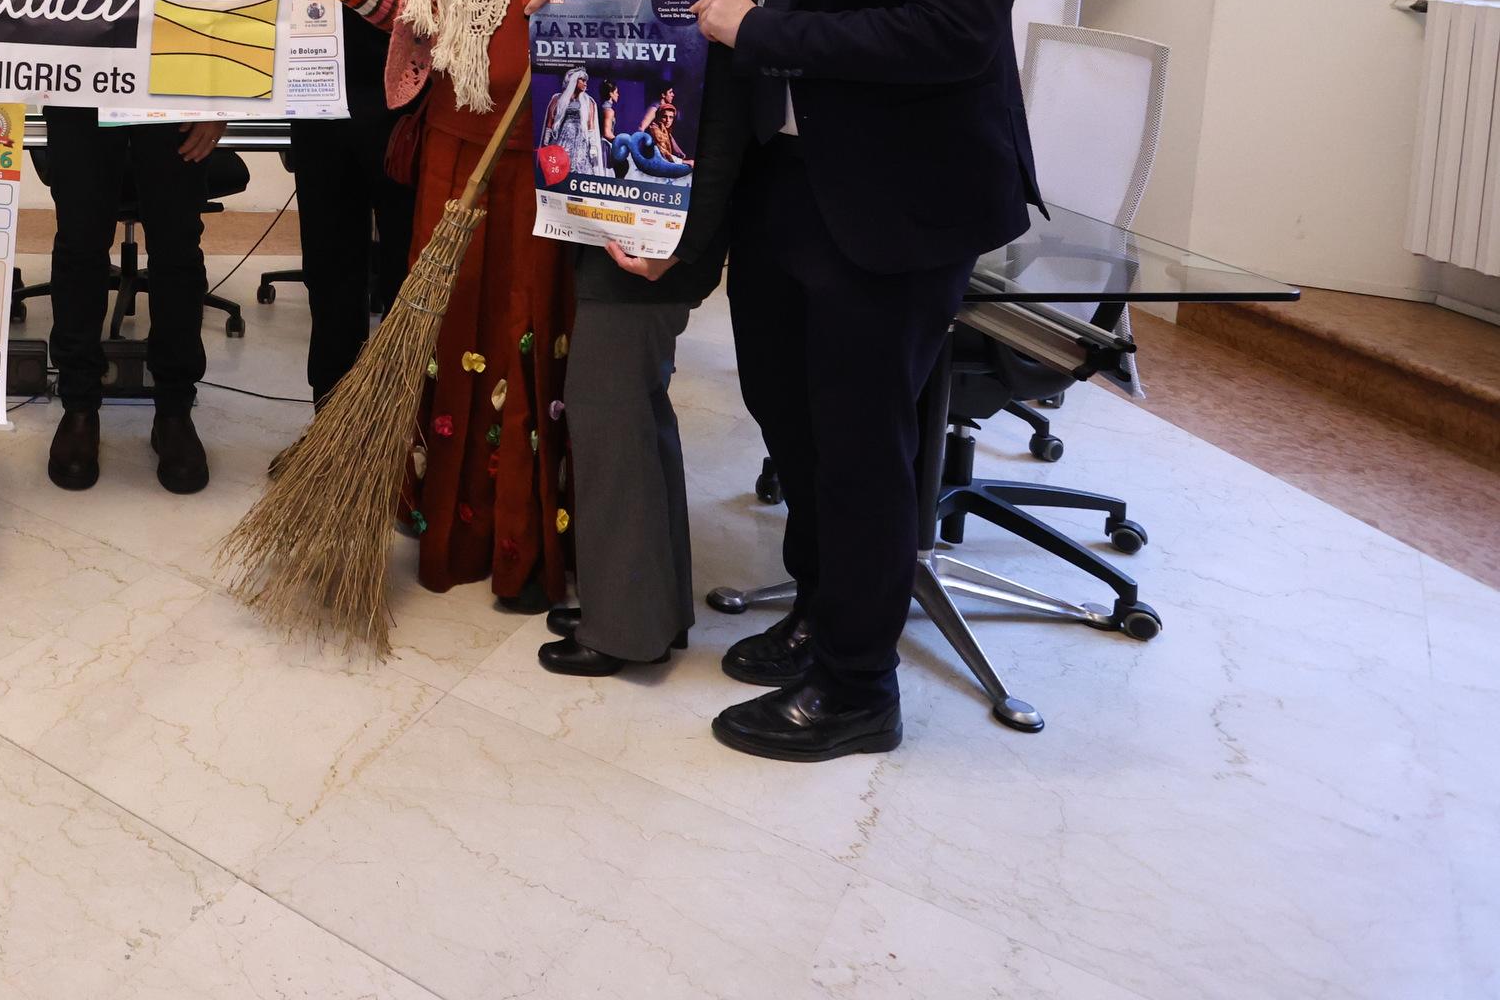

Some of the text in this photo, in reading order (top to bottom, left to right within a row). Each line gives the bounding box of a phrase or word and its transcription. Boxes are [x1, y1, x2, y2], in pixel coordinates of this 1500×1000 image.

[535, 20, 664, 40] LA REGINA
[299, 47, 328, 56] Bologna
[535, 40, 677, 62] DELLE NEVI
[92, 66, 136, 94] ets
[548, 155, 557, 164] 25
[551, 166, 560, 174] 26
[569, 179, 682, 206] 6 GENNAIO ORE 18
[605, 210, 633, 225] circoli
[544, 223, 573, 238] Duse
